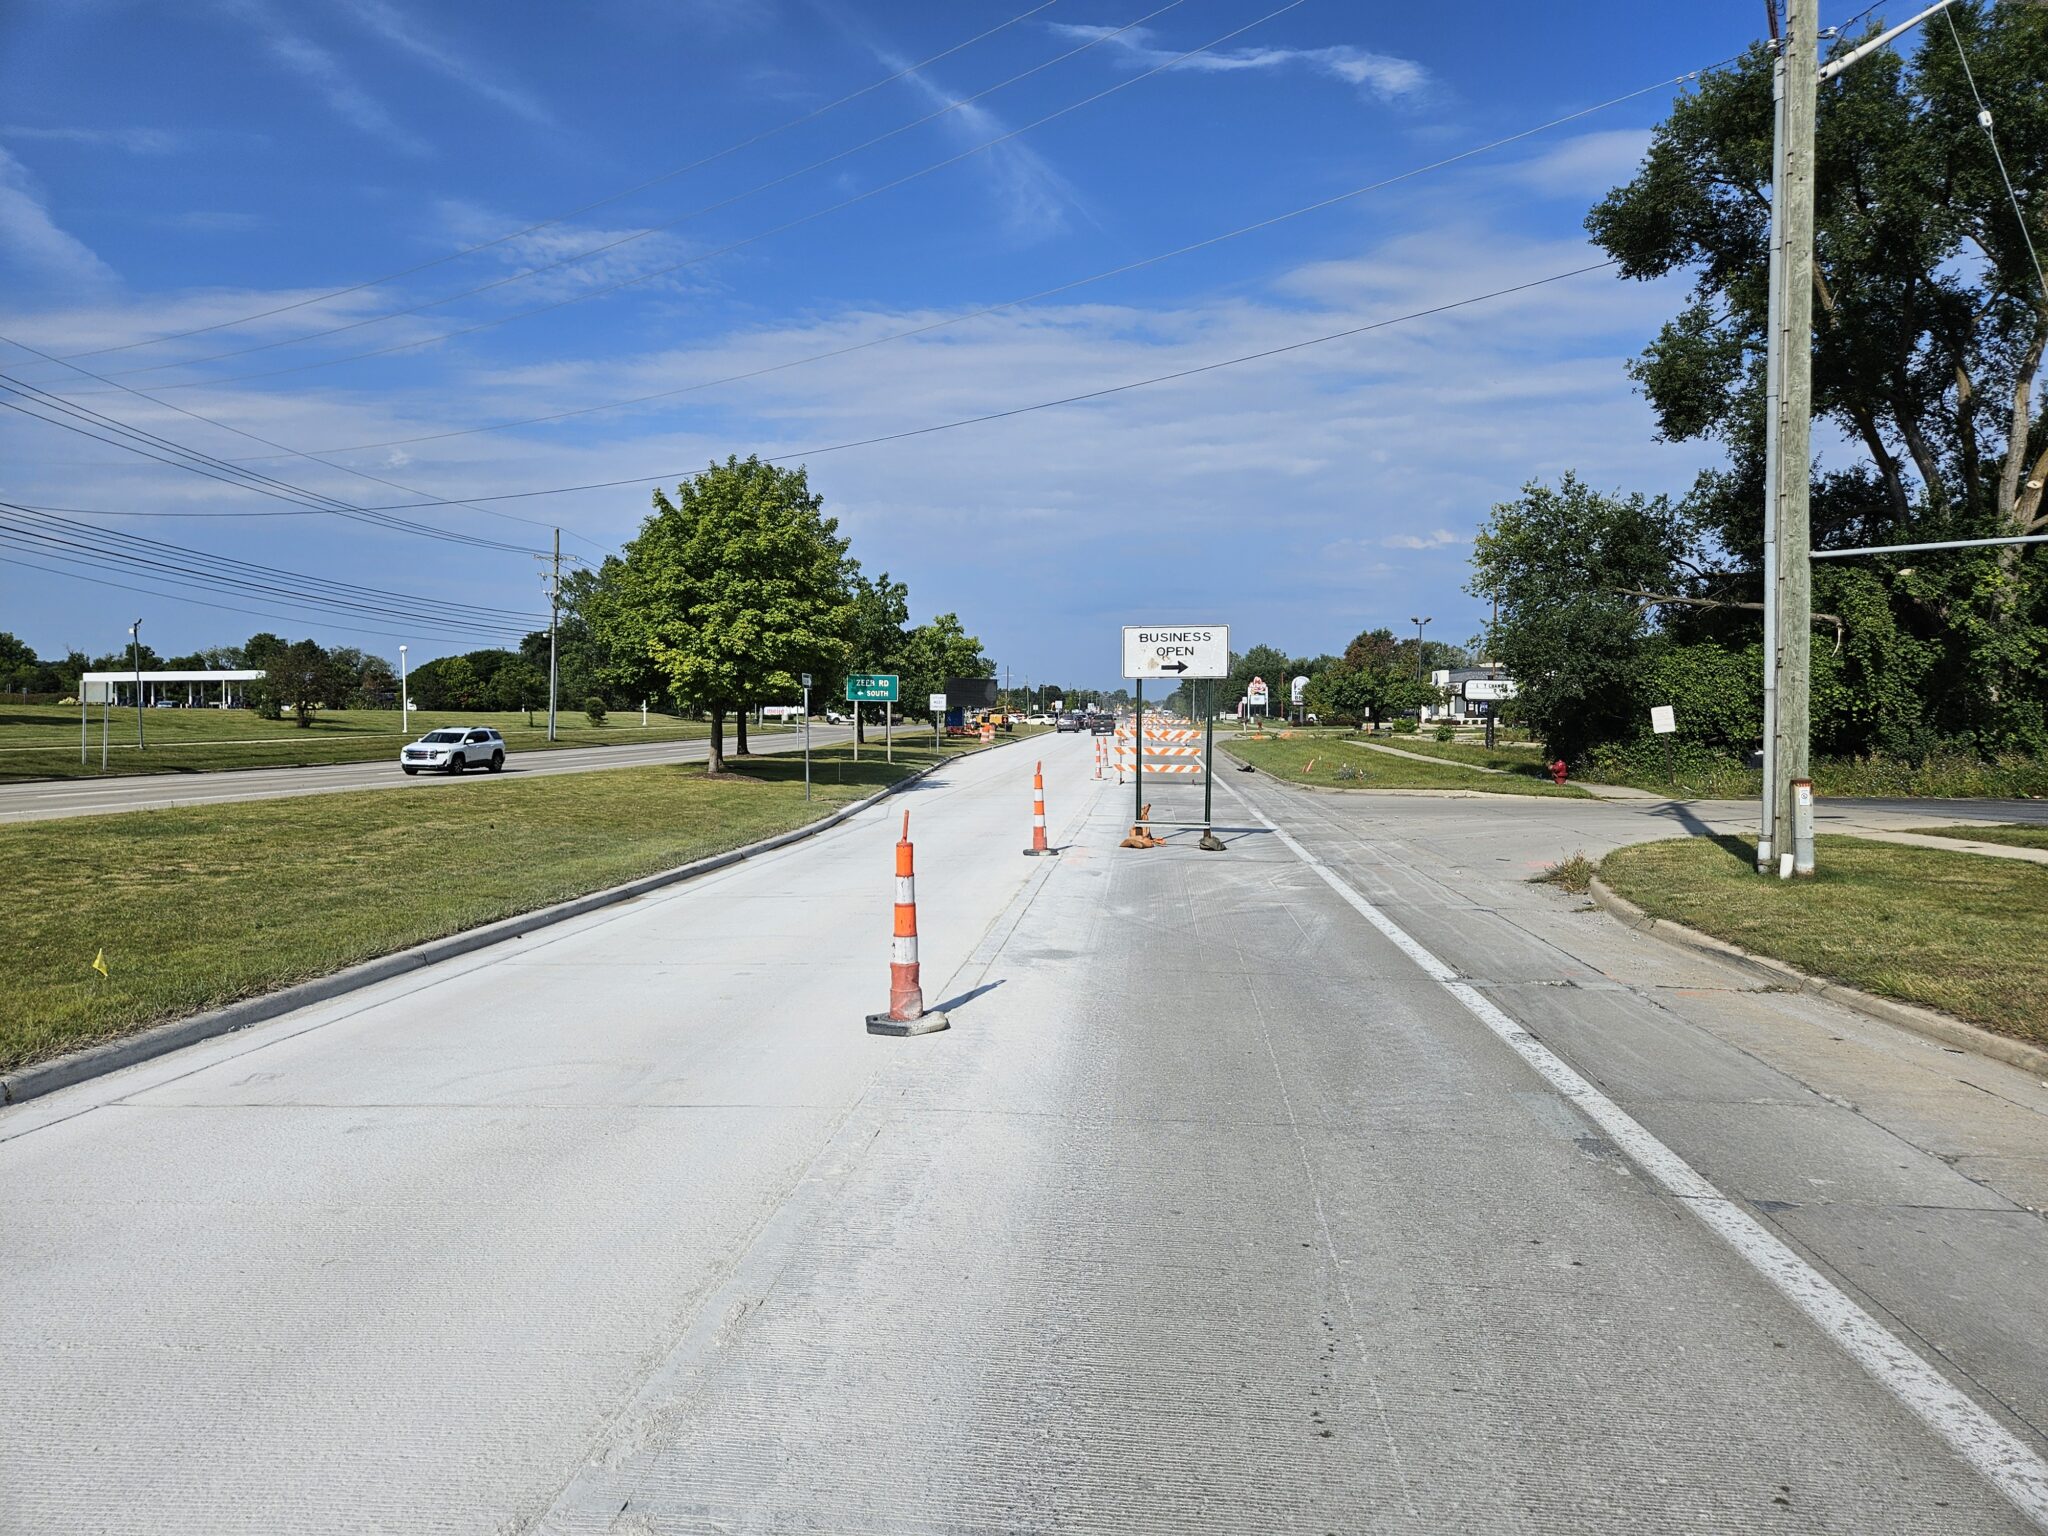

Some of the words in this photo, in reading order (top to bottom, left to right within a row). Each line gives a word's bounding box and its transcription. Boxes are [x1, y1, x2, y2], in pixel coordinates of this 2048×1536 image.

[1139, 632, 1211, 642] BUSINESS
[1156, 646, 1194, 656] OPEN
[856, 679, 875, 687] ZEEB
[878, 679, 889, 687] RD
